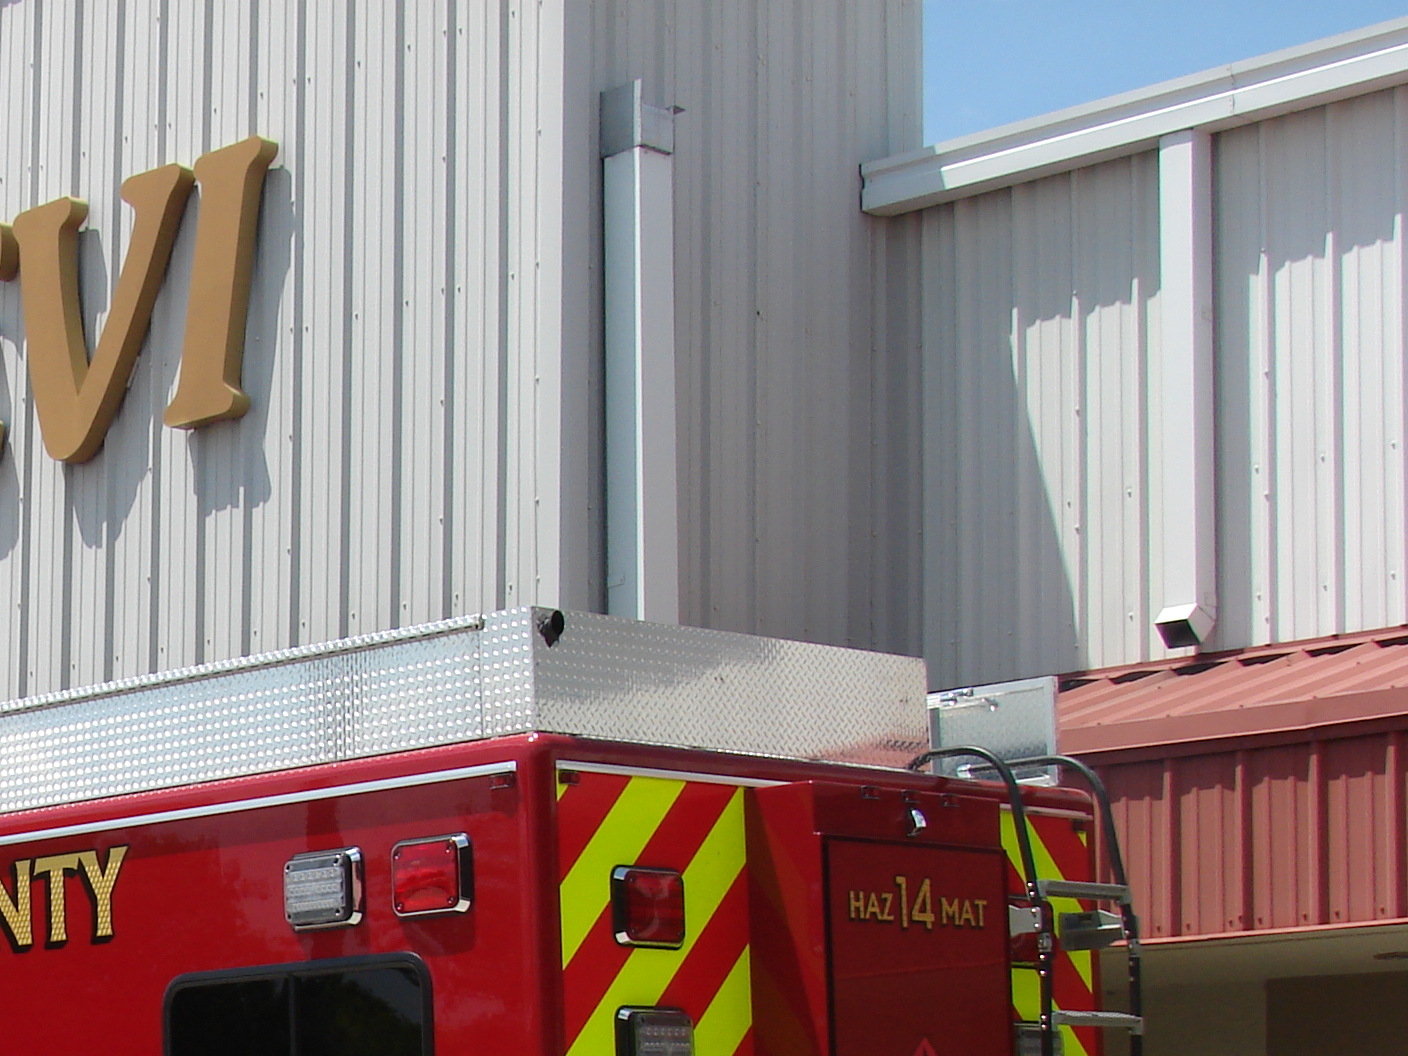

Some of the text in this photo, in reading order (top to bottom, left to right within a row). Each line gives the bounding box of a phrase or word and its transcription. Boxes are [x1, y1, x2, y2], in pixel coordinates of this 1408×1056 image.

[849, 875, 988, 930] HAZ 14 MAT
